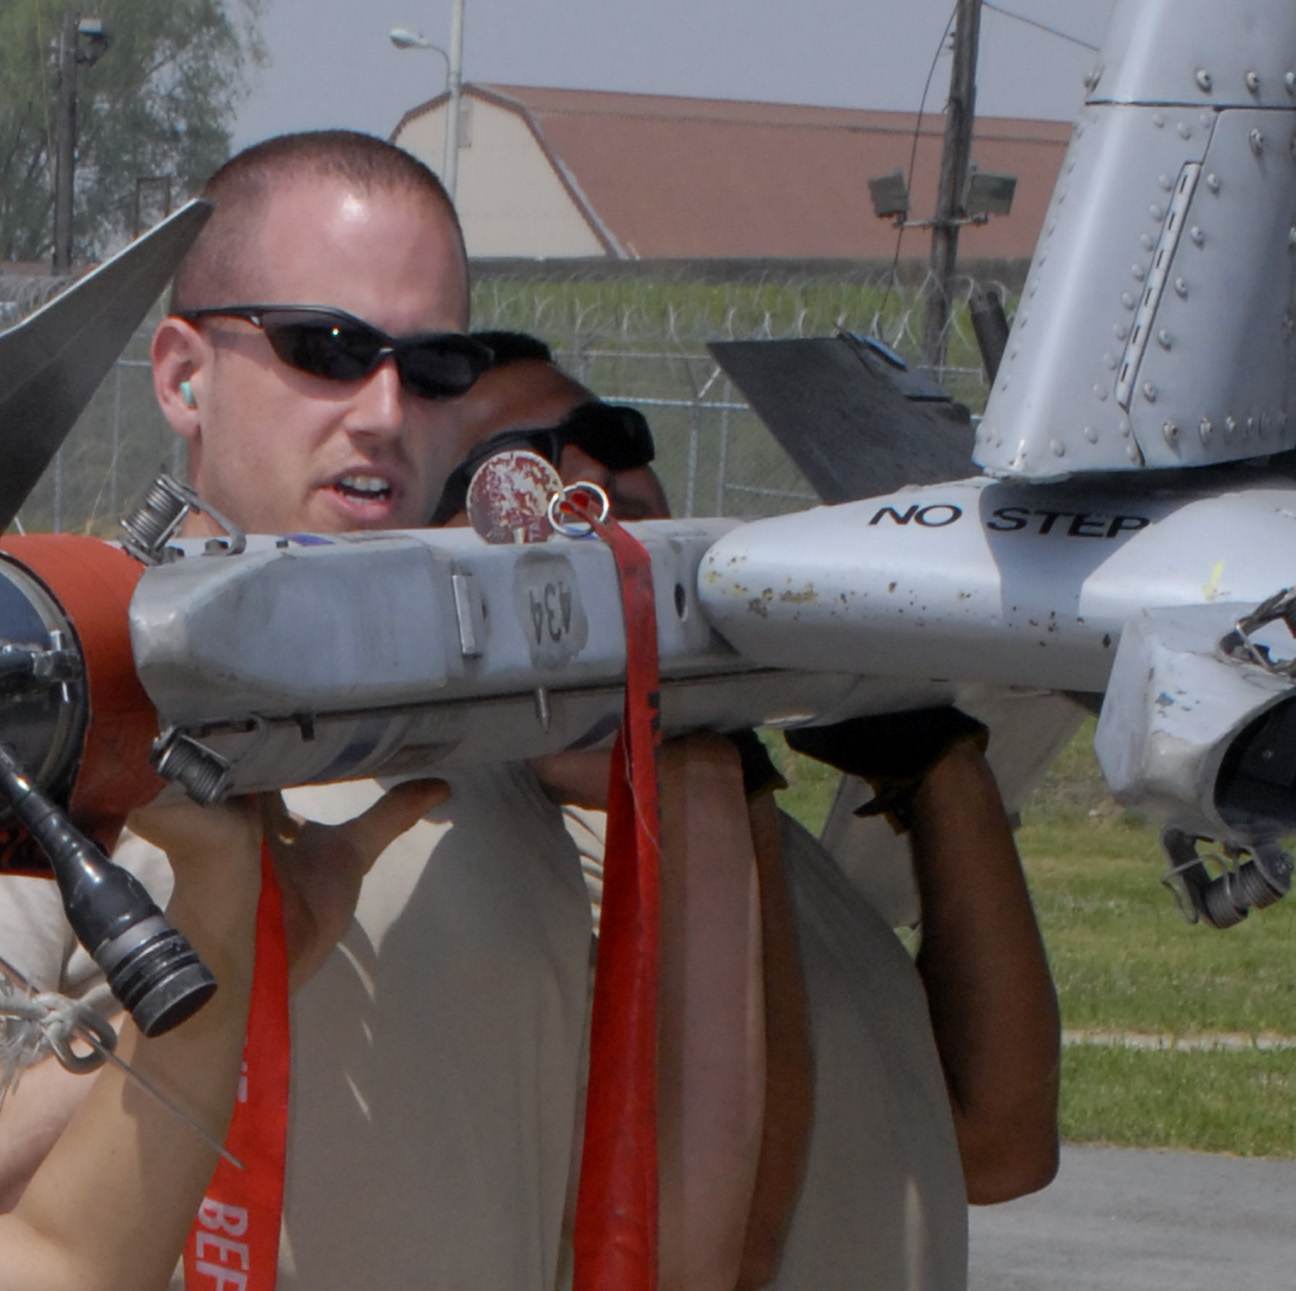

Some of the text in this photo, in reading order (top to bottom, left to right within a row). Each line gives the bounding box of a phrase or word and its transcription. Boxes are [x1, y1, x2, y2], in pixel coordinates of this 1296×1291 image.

[868, 503, 1151, 539] NO STEP
[527, 580, 573, 646] 434
